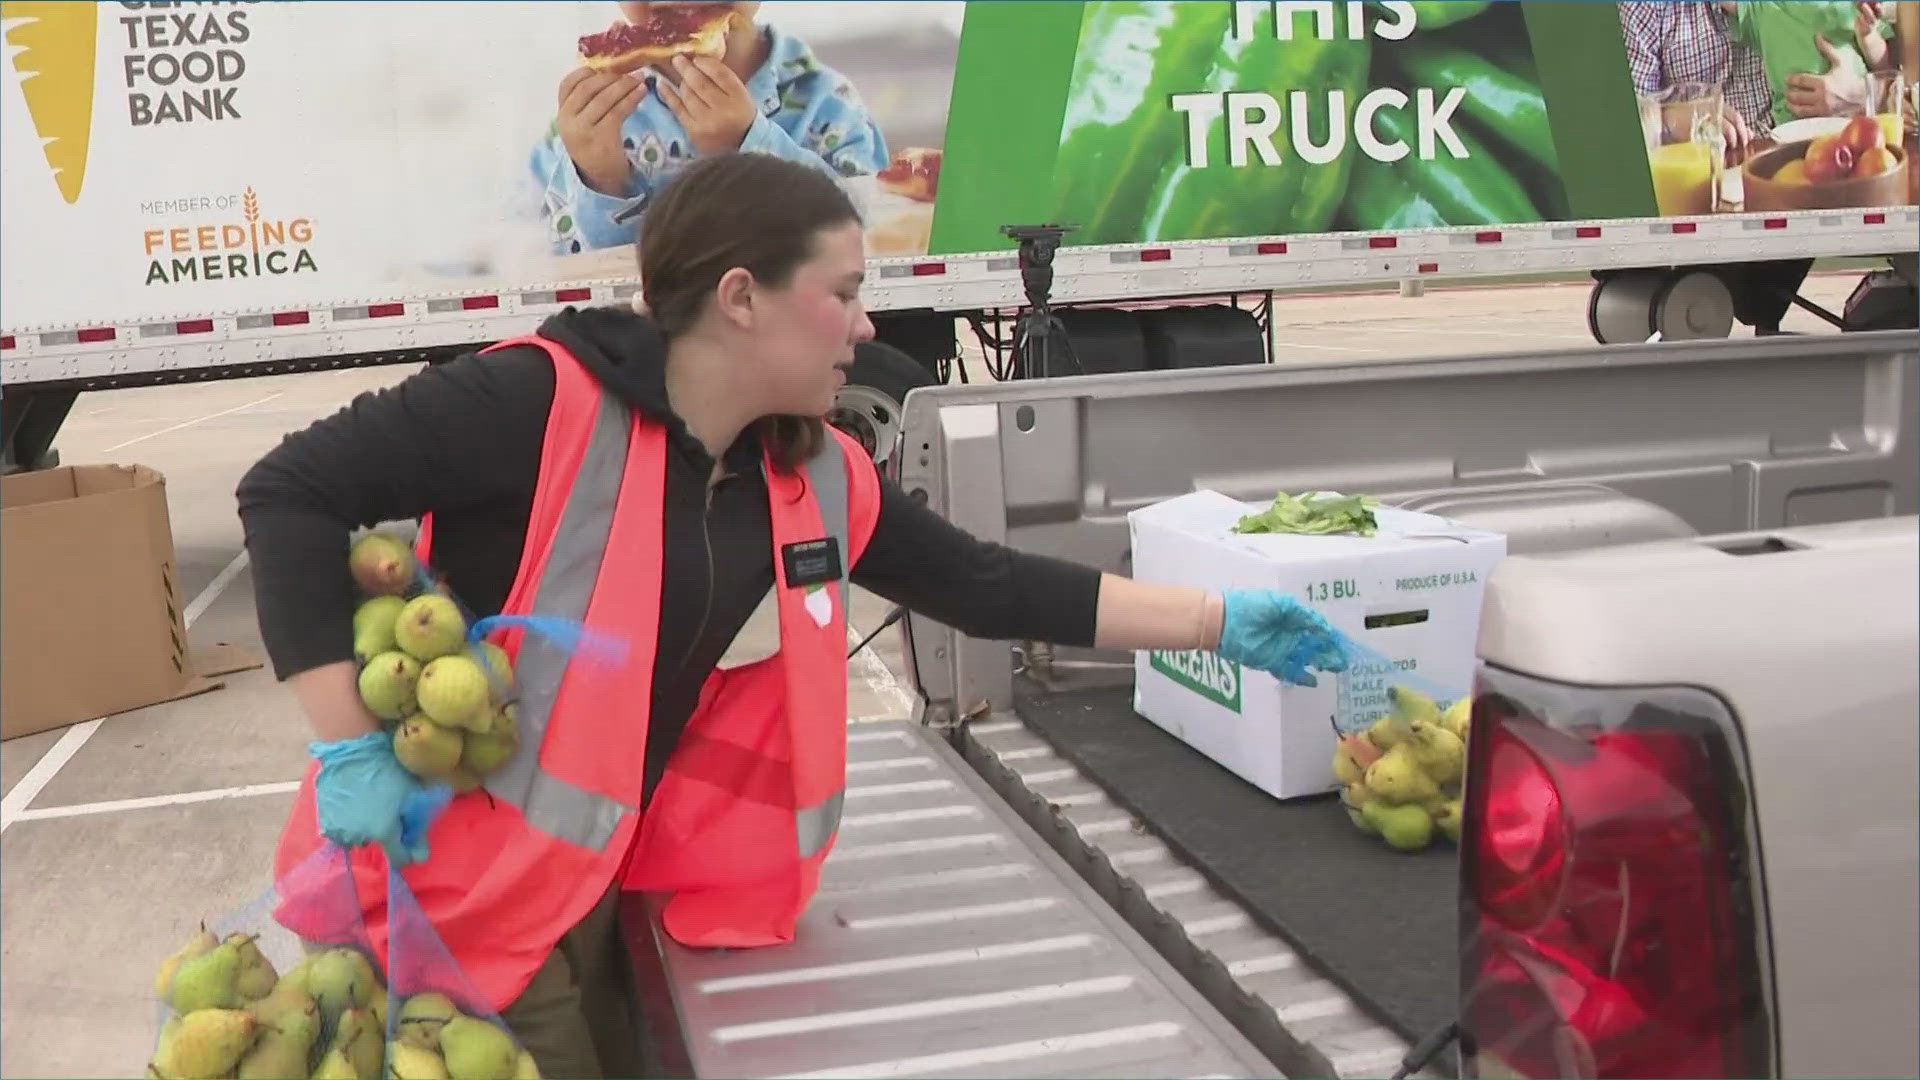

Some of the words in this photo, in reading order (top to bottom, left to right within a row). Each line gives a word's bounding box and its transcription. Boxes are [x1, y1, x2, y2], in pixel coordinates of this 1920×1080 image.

[120, 11, 250, 48] TEXAS
[124, 50, 246, 87] FOOD
[129, 88, 241, 126] BANK
[1171, 87, 1470, 168] TRUCK
[140, 198, 211, 215] MEMBER
[216, 196, 239, 210] OF
[144, 218, 312, 255] FEEDING
[145, 248, 318, 286] AMERICA
[1306, 582, 1328, 602] 1.3
[1333, 579, 1360, 599] BU.
[1395, 575, 1438, 591] PRODUCE
[1440, 573, 1451, 586] OF
[1351, 679, 1384, 692] KALE
